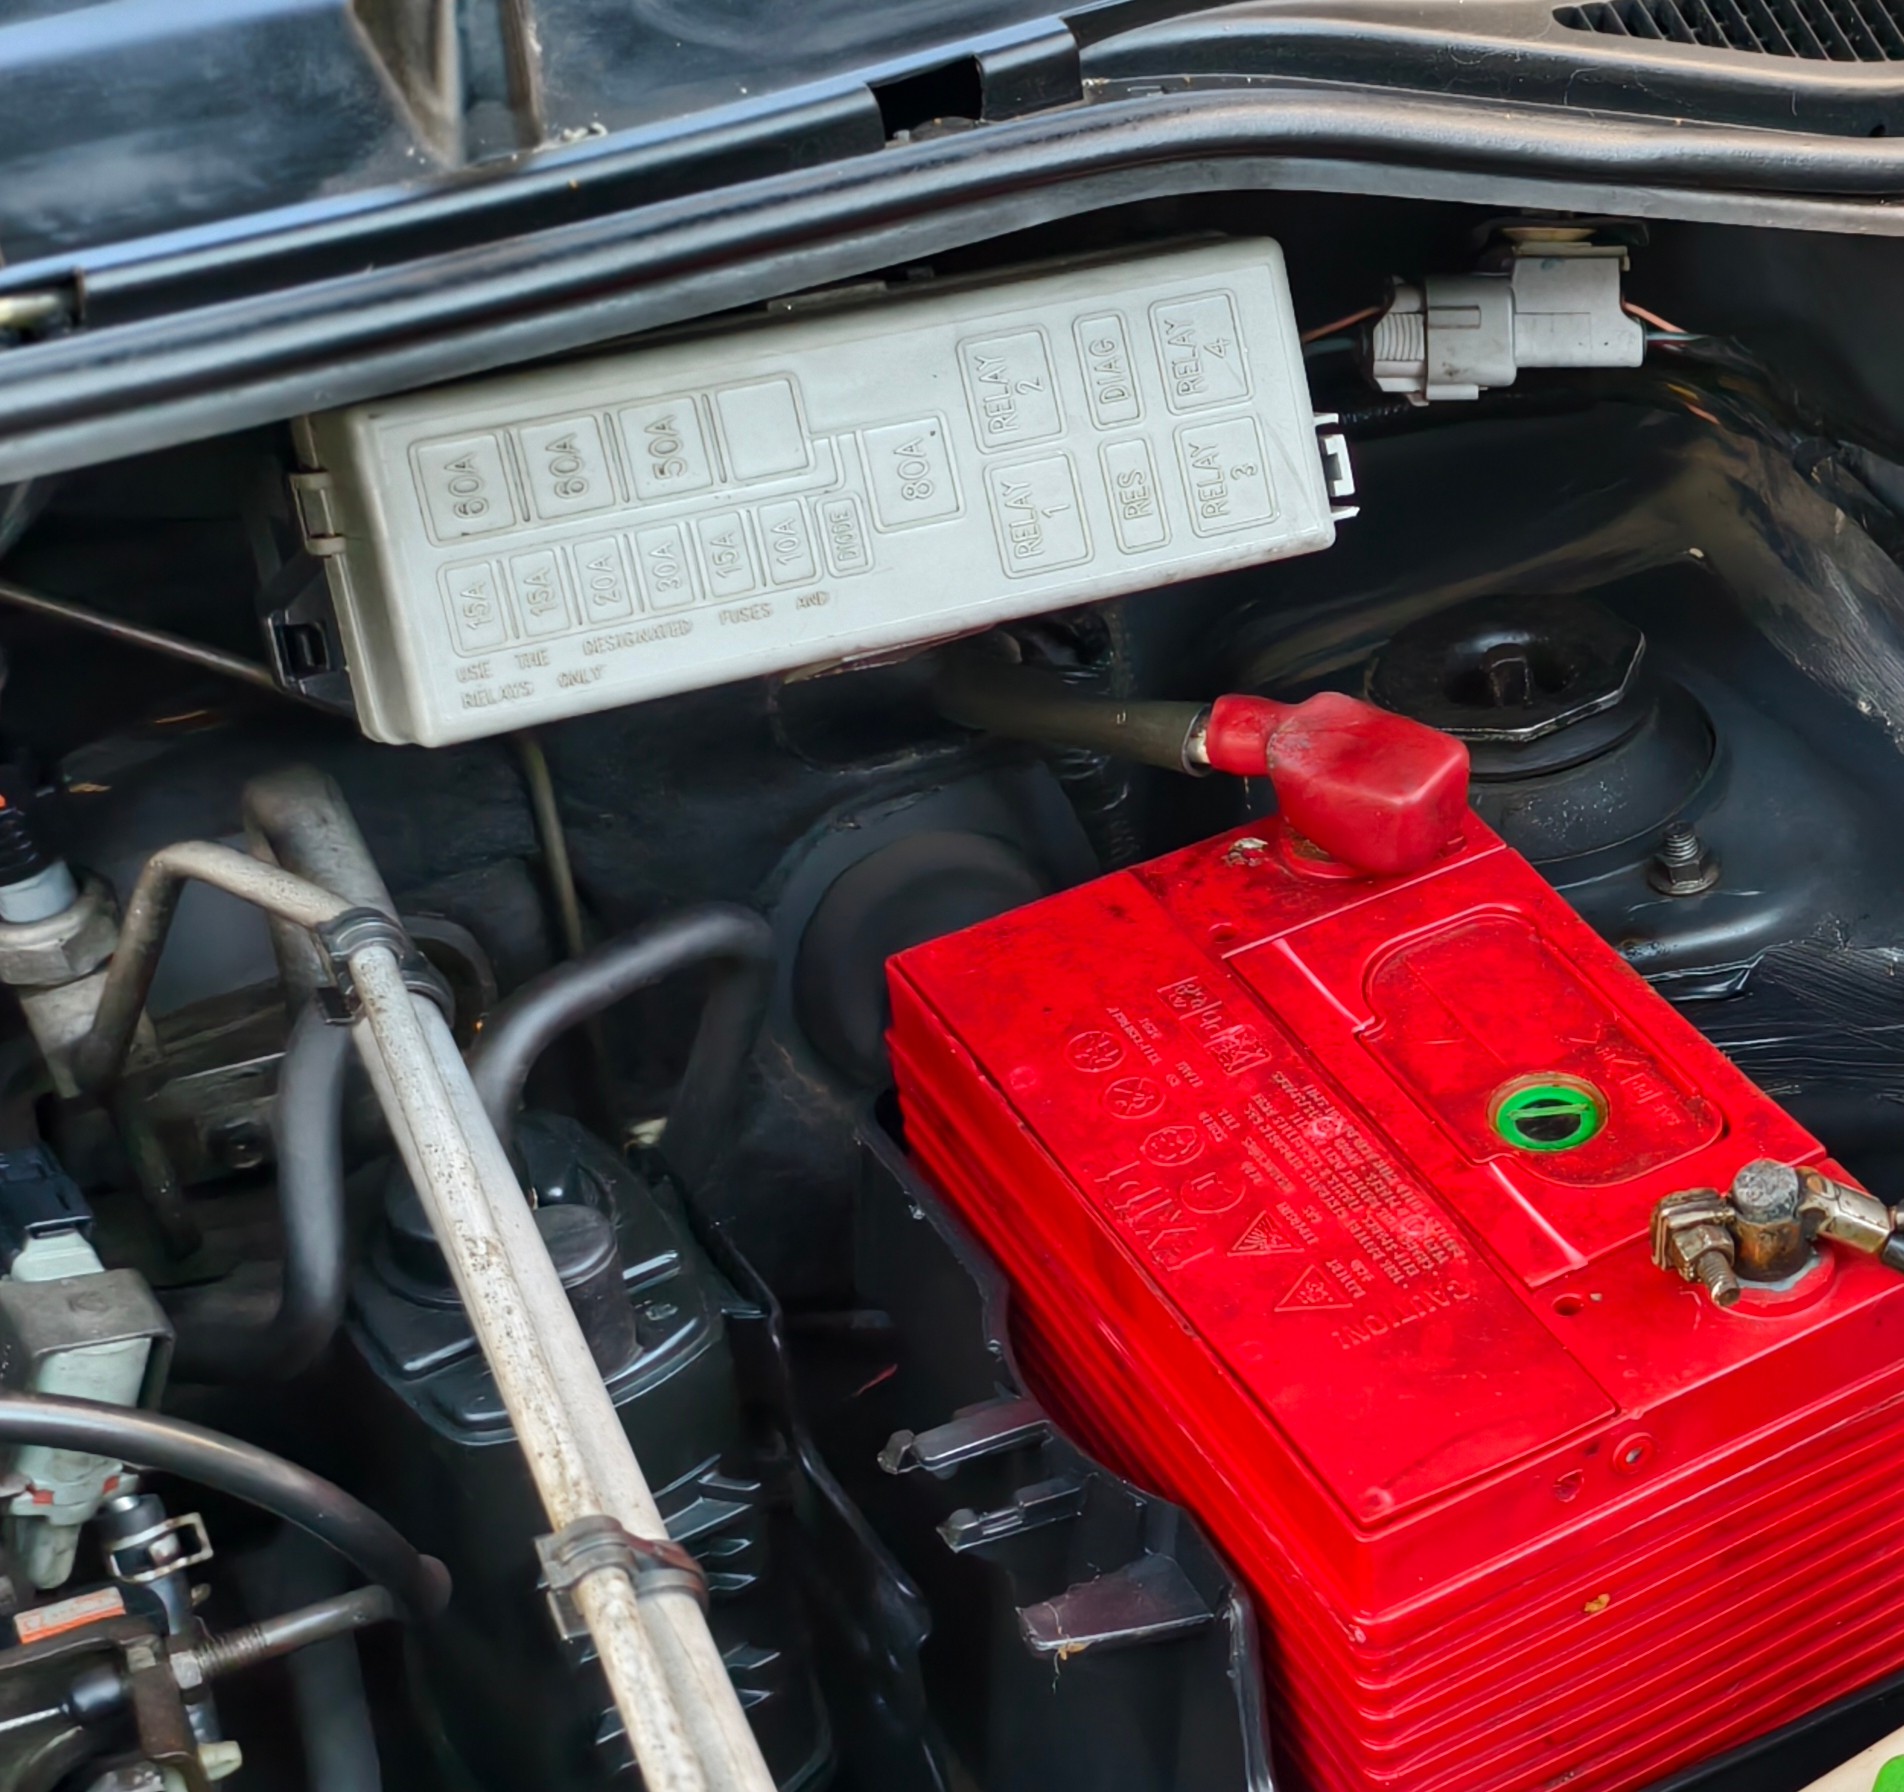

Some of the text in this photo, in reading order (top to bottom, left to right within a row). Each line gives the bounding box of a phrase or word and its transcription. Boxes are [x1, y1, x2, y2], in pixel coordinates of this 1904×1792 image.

[1088, 338, 1131, 405] DIAG
[1163, 319, 1208, 396] RELAY
[1203, 338, 1231, 358] 4
[974, 356, 1019, 435] RELAY
[1015, 376, 1046, 395] 2
[545, 433, 589, 499] 60A
[644, 415, 688, 480] 50A
[893, 437, 935, 501] 80A
[1230, 463, 1258, 481] 3
[1116, 469, 1153, 520] RES
[1188, 442, 1231, 519] RELAY
[830, 509, 859, 563] DIODE
[1000, 481, 1045, 559] RELAY
[1041, 504, 1071, 518] 1
[650, 541, 684, 593] 30A
[710, 530, 743, 580] 15A
[771, 517, 803, 567] 10A
[460, 580, 494, 631] 15A
[523, 567, 557, 617] 15A
[586, 555, 622, 607] 20A
[456, 590, 831, 684] USE THE DESIGNATED FUSES AND
[460, 664, 607, 710] RELAYS ONLY
